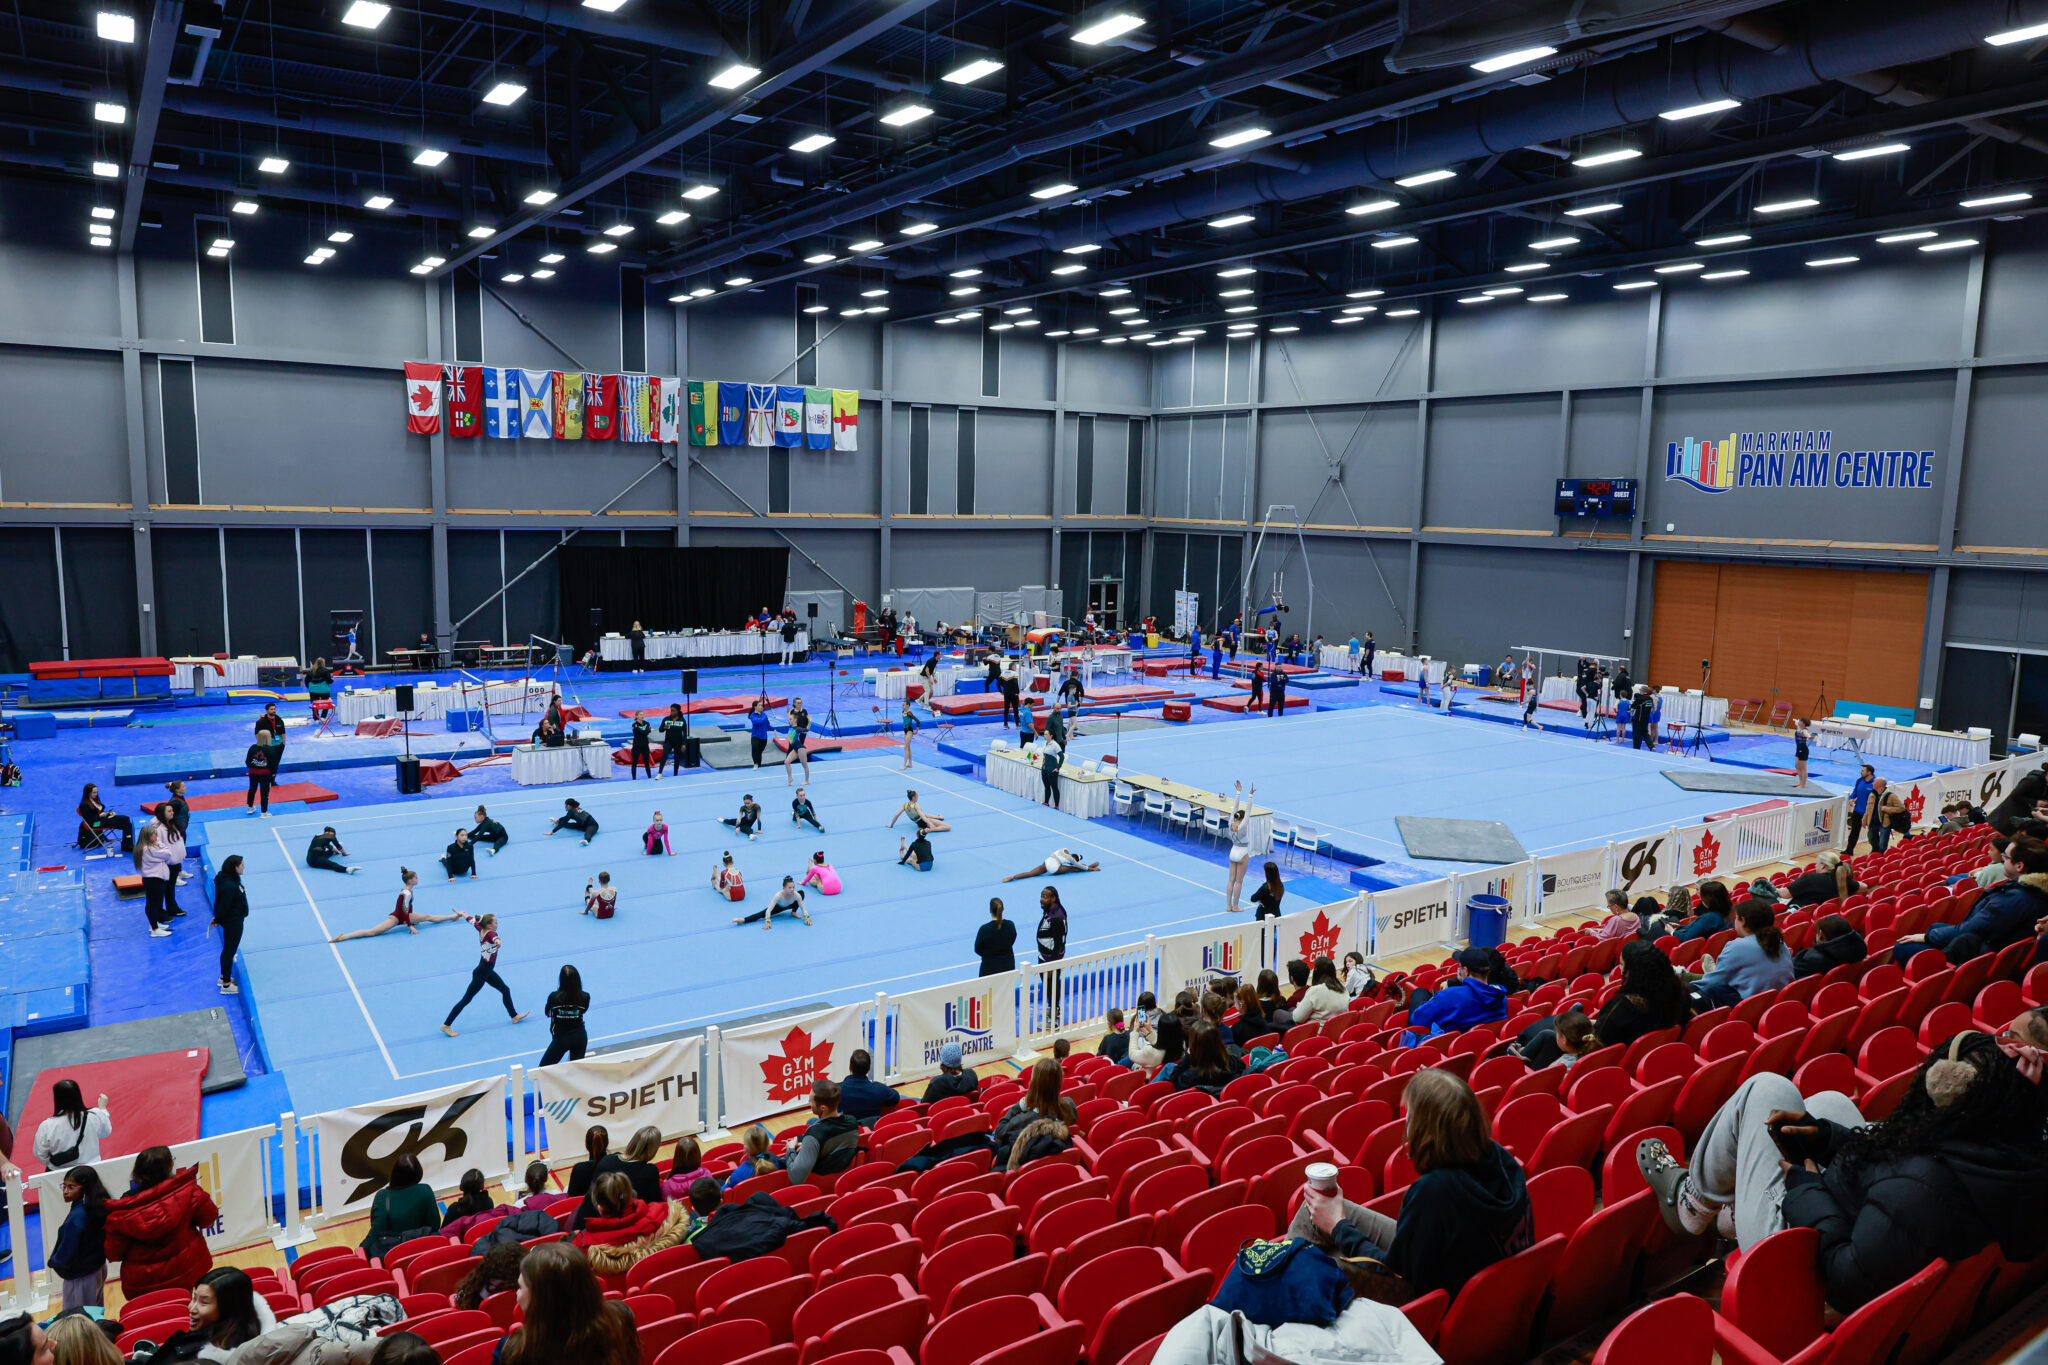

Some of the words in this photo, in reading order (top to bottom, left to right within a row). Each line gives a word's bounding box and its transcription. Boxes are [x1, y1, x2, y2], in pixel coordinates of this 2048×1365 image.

[1740, 430, 1832, 452] MARKHAM
[1737, 452, 1785, 488] PAN
[1788, 452, 1831, 488] AM
[1834, 450, 1936, 489] CENTRE
[1945, 788, 1972, 803] SPIETH
[1699, 847, 1713, 860] GYM
[1699, 859, 1712, 869] CAN
[1556, 872, 1602, 888] BOUTIQUEGYM
[1393, 901, 1448, 929] SPIETH
[1311, 934, 1330, 950] GYM
[1309, 948, 1328, 962] CAN
[1185, 974, 1214, 987] MARKHAM
[961, 1034, 994, 1056] CENTRE
[782, 1055, 815, 1077] GYM
[783, 1070, 815, 1092] CAN
[586, 1071, 698, 1117] SPIETH
